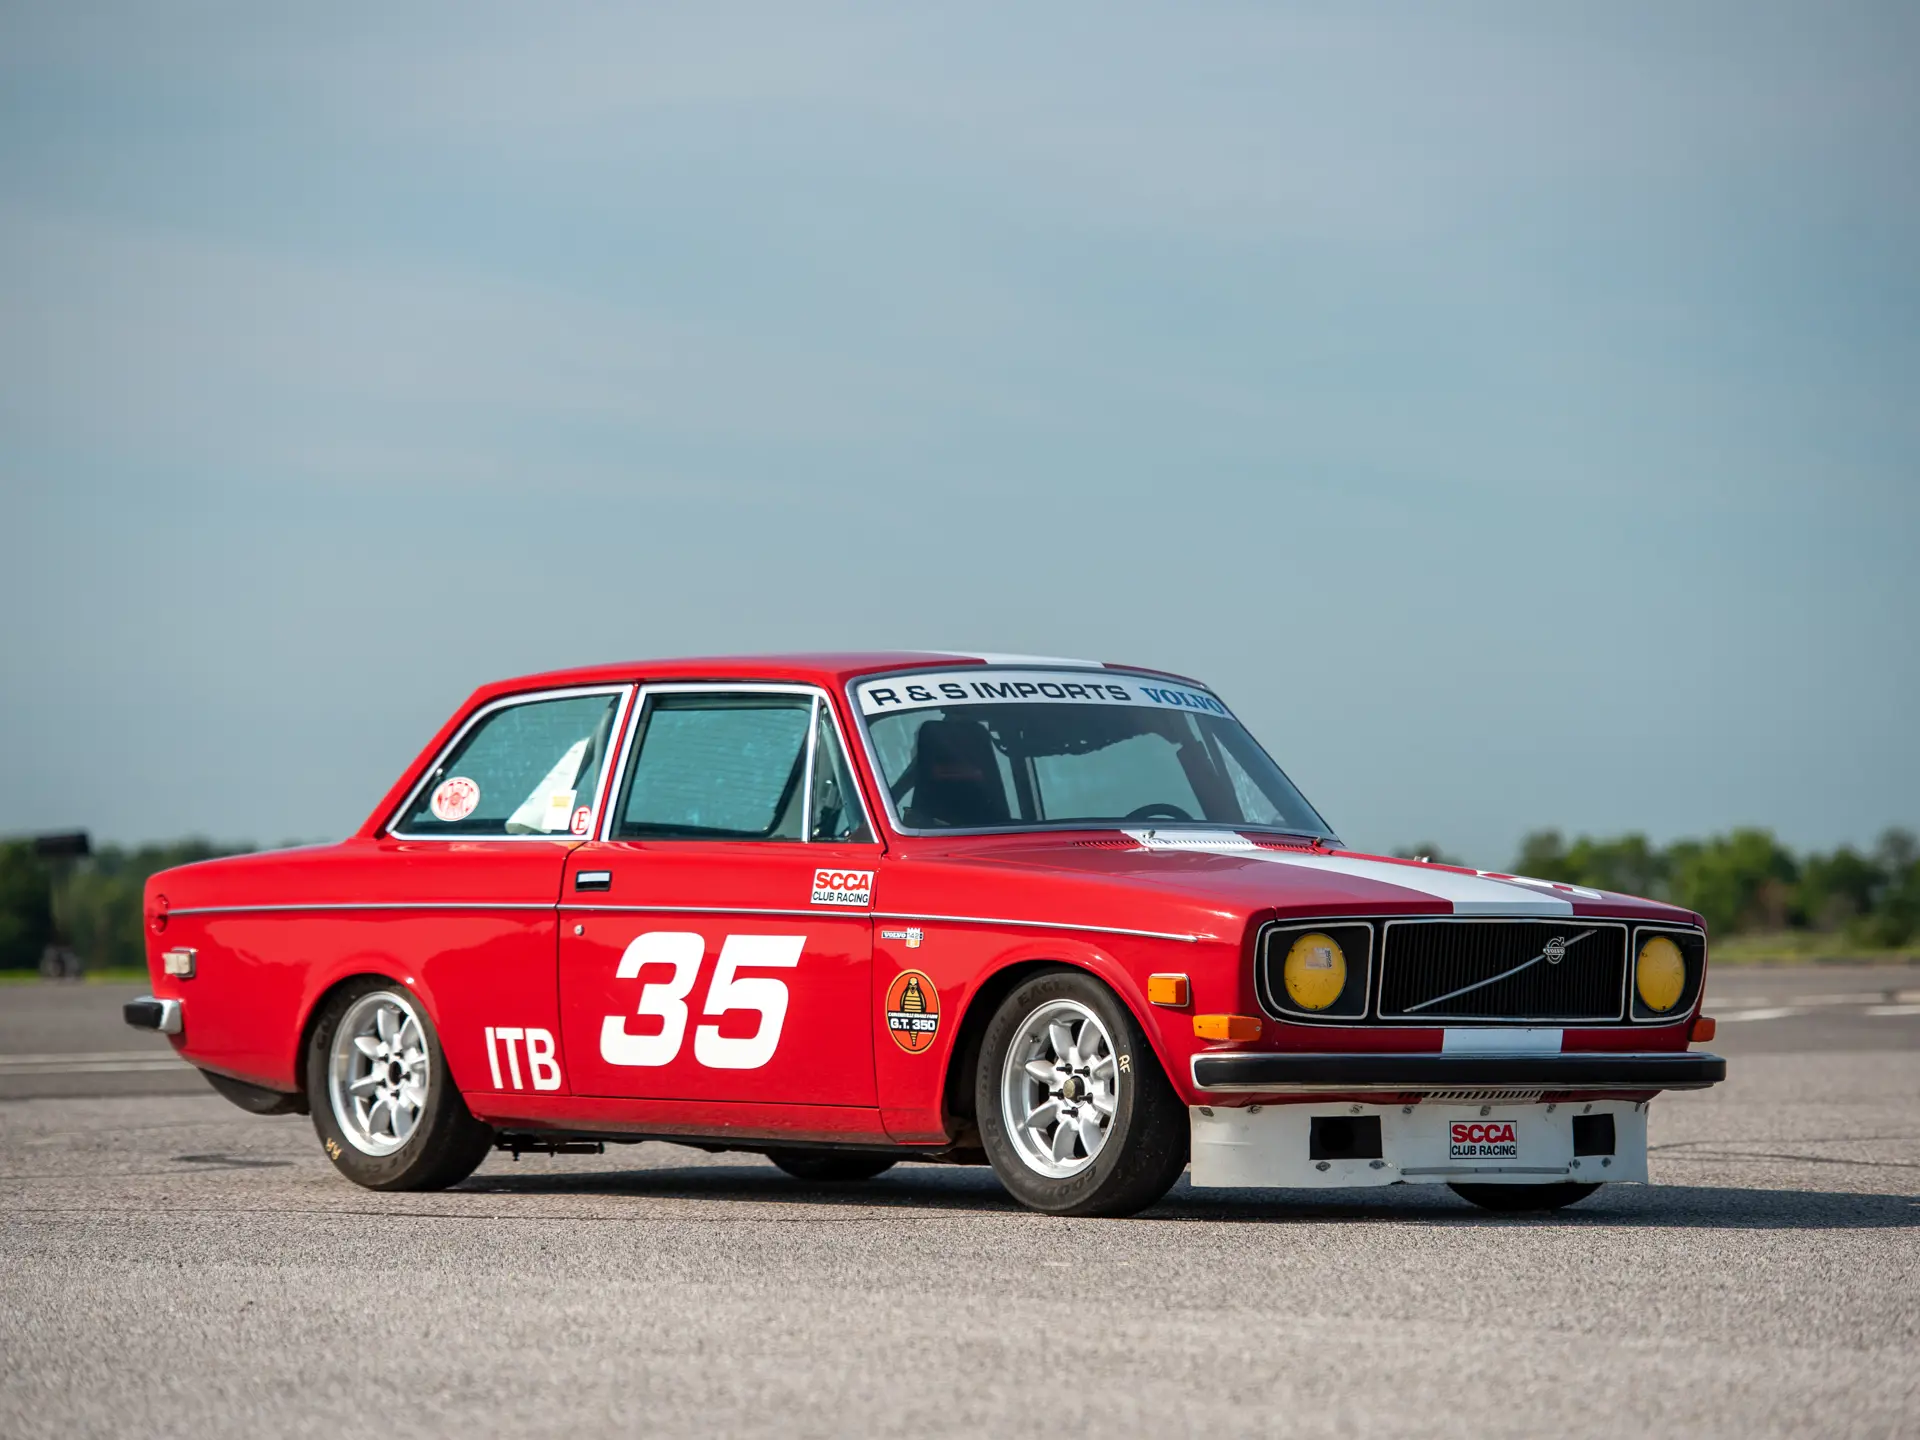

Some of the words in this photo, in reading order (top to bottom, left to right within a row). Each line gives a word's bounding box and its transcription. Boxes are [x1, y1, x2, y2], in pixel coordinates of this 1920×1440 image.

[868, 688, 901, 706] R
[906, 684, 937, 701] &
[944, 683, 973, 700] S
[970, 682, 1132, 702] IMPORTS
[1139, 686, 1226, 715] VOLVO
[575, 811, 588, 831] E
[815, 871, 870, 891] SCCA
[812, 891, 835, 902] CLUB
[836, 893, 869, 903] RACING
[884, 931, 907, 939] VOLVO
[600, 931, 807, 1069] 35
[890, 1018, 910, 1030] G.T.
[911, 1019, 936, 1031] 350
[484, 1026, 562, 1091] ITB
[1118, 1054, 1131, 1074] RF
[1451, 1124, 1516, 1143] SCCA
[1451, 1145, 1477, 1156] CLUB
[1479, 1145, 1516, 1156] RACING
